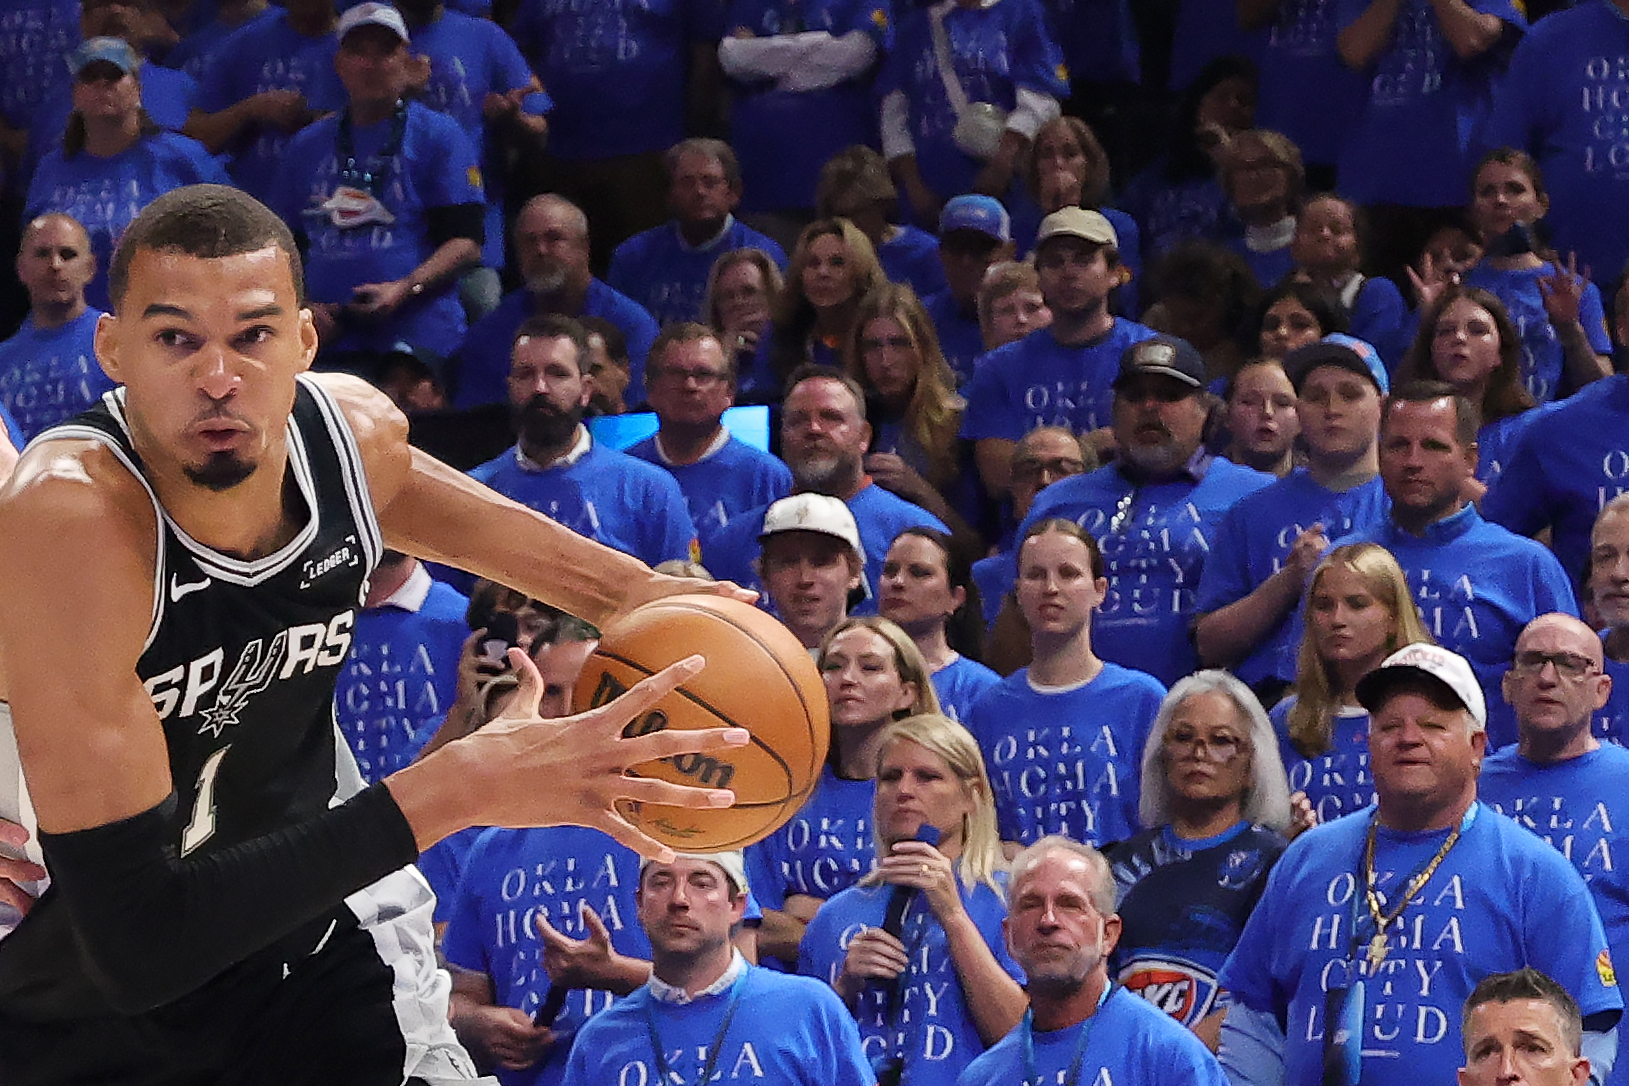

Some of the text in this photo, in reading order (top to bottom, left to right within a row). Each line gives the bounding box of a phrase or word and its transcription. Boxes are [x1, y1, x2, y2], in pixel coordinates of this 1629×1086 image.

[309, 547, 351, 580] LEDGER
[143, 609, 355, 735] SPURS
[993, 725, 1119, 766] OKLA
[1289, 754, 1372, 792] OKL
[180, 743, 233, 859] 1
[1490, 796, 1614, 833] KLA
[786, 817, 875, 853] OKL
[501, 854, 620, 902] OKLA
[1310, 914, 1465, 954] HMA
[1306, 1003, 1449, 1045] LUD
